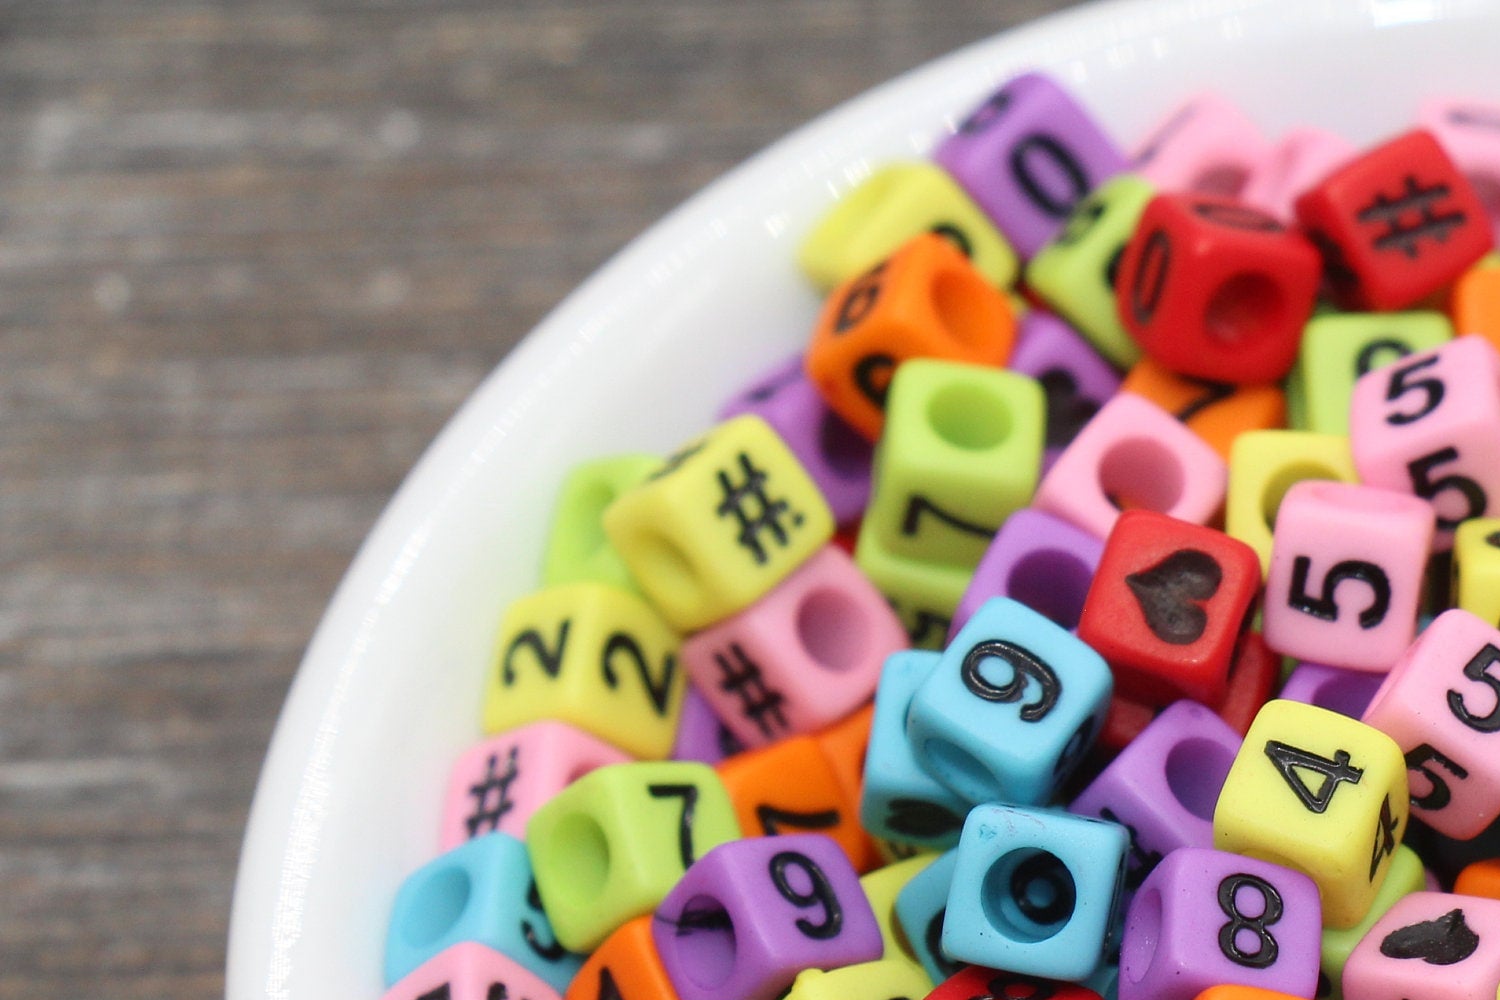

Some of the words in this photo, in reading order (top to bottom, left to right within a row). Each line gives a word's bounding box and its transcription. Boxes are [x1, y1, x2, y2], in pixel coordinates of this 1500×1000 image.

[1008, 134, 1091, 220] 0
[1356, 176, 1465, 258] #
[1132, 231, 1171, 327] 0
[1385, 355, 1446, 426] 5
[717, 452, 788, 564] #
[1287, 555, 1392, 630] 5
[503, 620, 570, 687] 2
[602, 631, 674, 717] 2
[713, 643, 788, 738] #
[960, 638, 1063, 723] 9
[465, 747, 519, 837] #
[1263, 739, 1365, 814] 4
[1406, 743, 1470, 811] 5
[647, 783, 698, 870] 7
[768, 851, 843, 939] 9
[1217, 872, 1284, 970] 8
